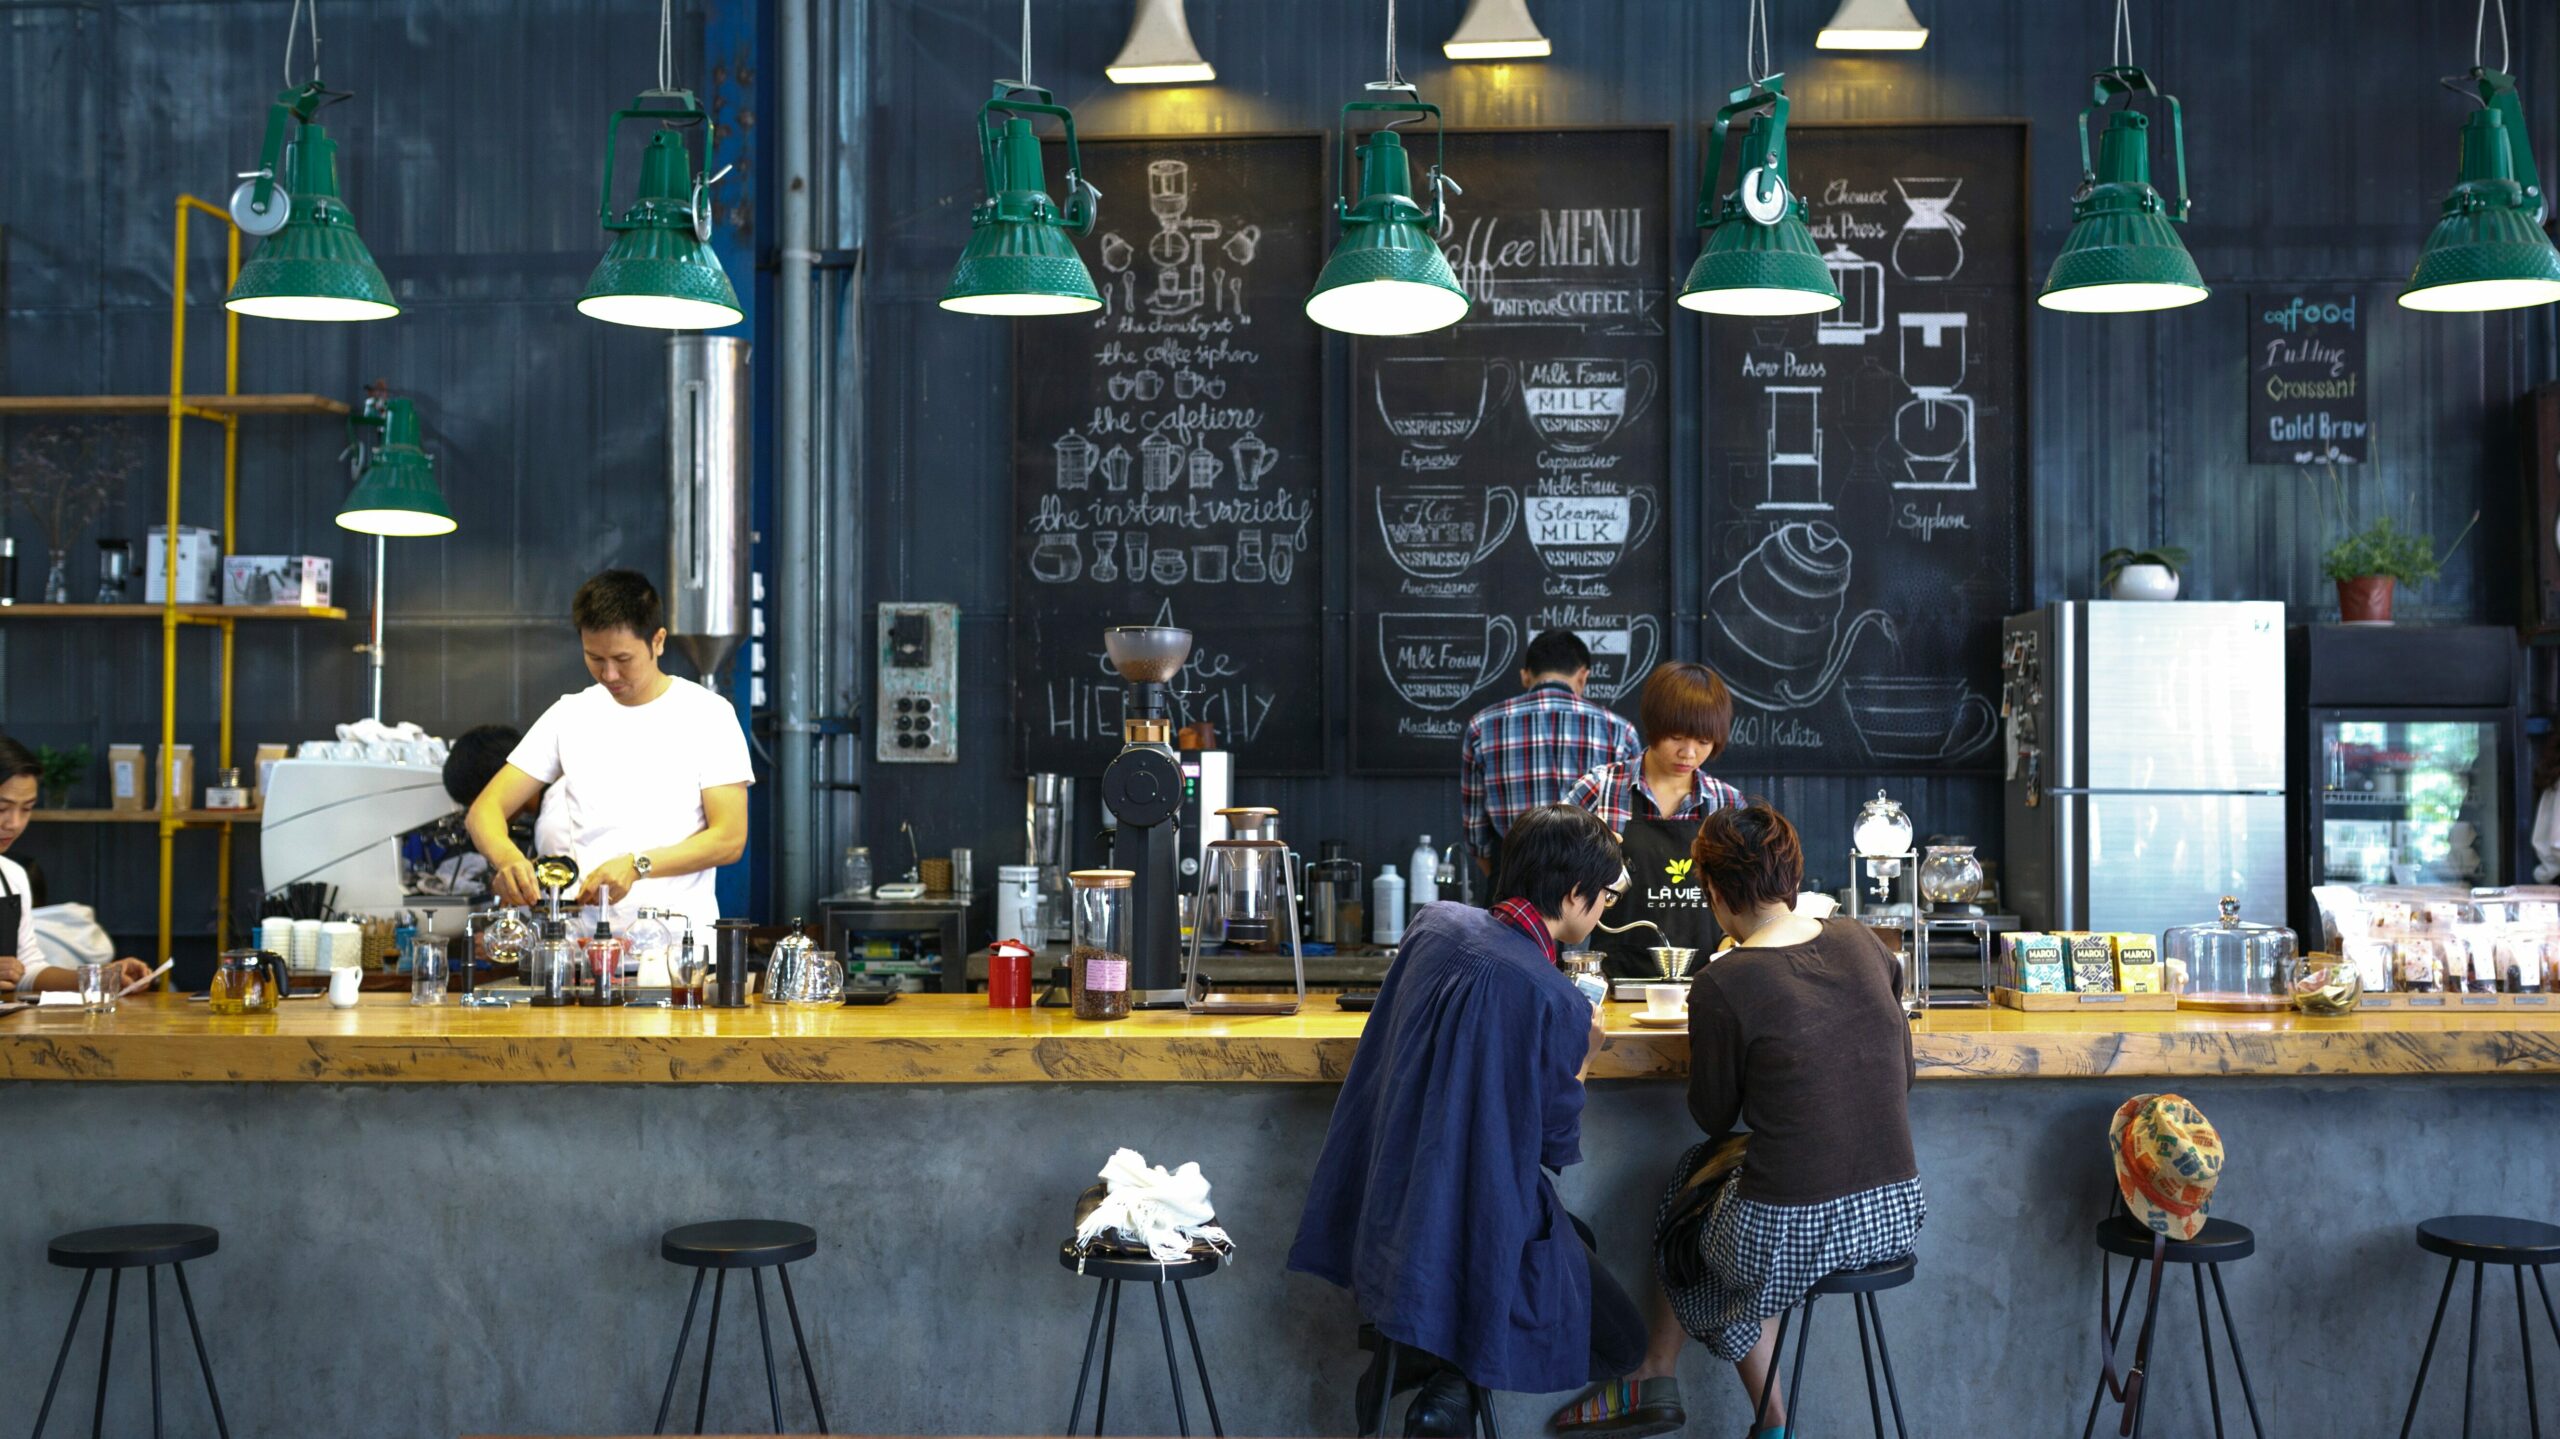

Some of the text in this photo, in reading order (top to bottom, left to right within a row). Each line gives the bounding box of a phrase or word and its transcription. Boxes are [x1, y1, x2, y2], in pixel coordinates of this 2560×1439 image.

[1540, 209, 1642, 266] MENU
[1556, 290, 1629, 316] COFFEE
[1095, 337, 1259, 370] the coffee siphon
[1784, 351, 1827, 378] Press
[1530, 362, 1621, 385] Milk Foam
[2267, 372, 2356, 402] Croissant
[1539, 391, 1611, 411] MILK
[1088, 407, 1136, 435] the
[2270, 411, 2367, 441] Cold Brew
[1538, 473, 1619, 496] Milk Foam
[1029, 487, 1314, 550] the instant variety
[1898, 502, 1971, 541] Syphon
[1540, 523, 1611, 541] MILK
[1542, 604, 1620, 627] Milk Foam
[1397, 647, 1435, 669] Milk
[1088, 648, 1240, 699] cee
[1771, 718, 1823, 747] Kalita
[1648, 885, 1704, 902] LÀ VIỆ
[2029, 949, 2056, 958] MAROU
[2077, 949, 2104, 958] MAROU
[2124, 950, 2151, 959] MAROU
